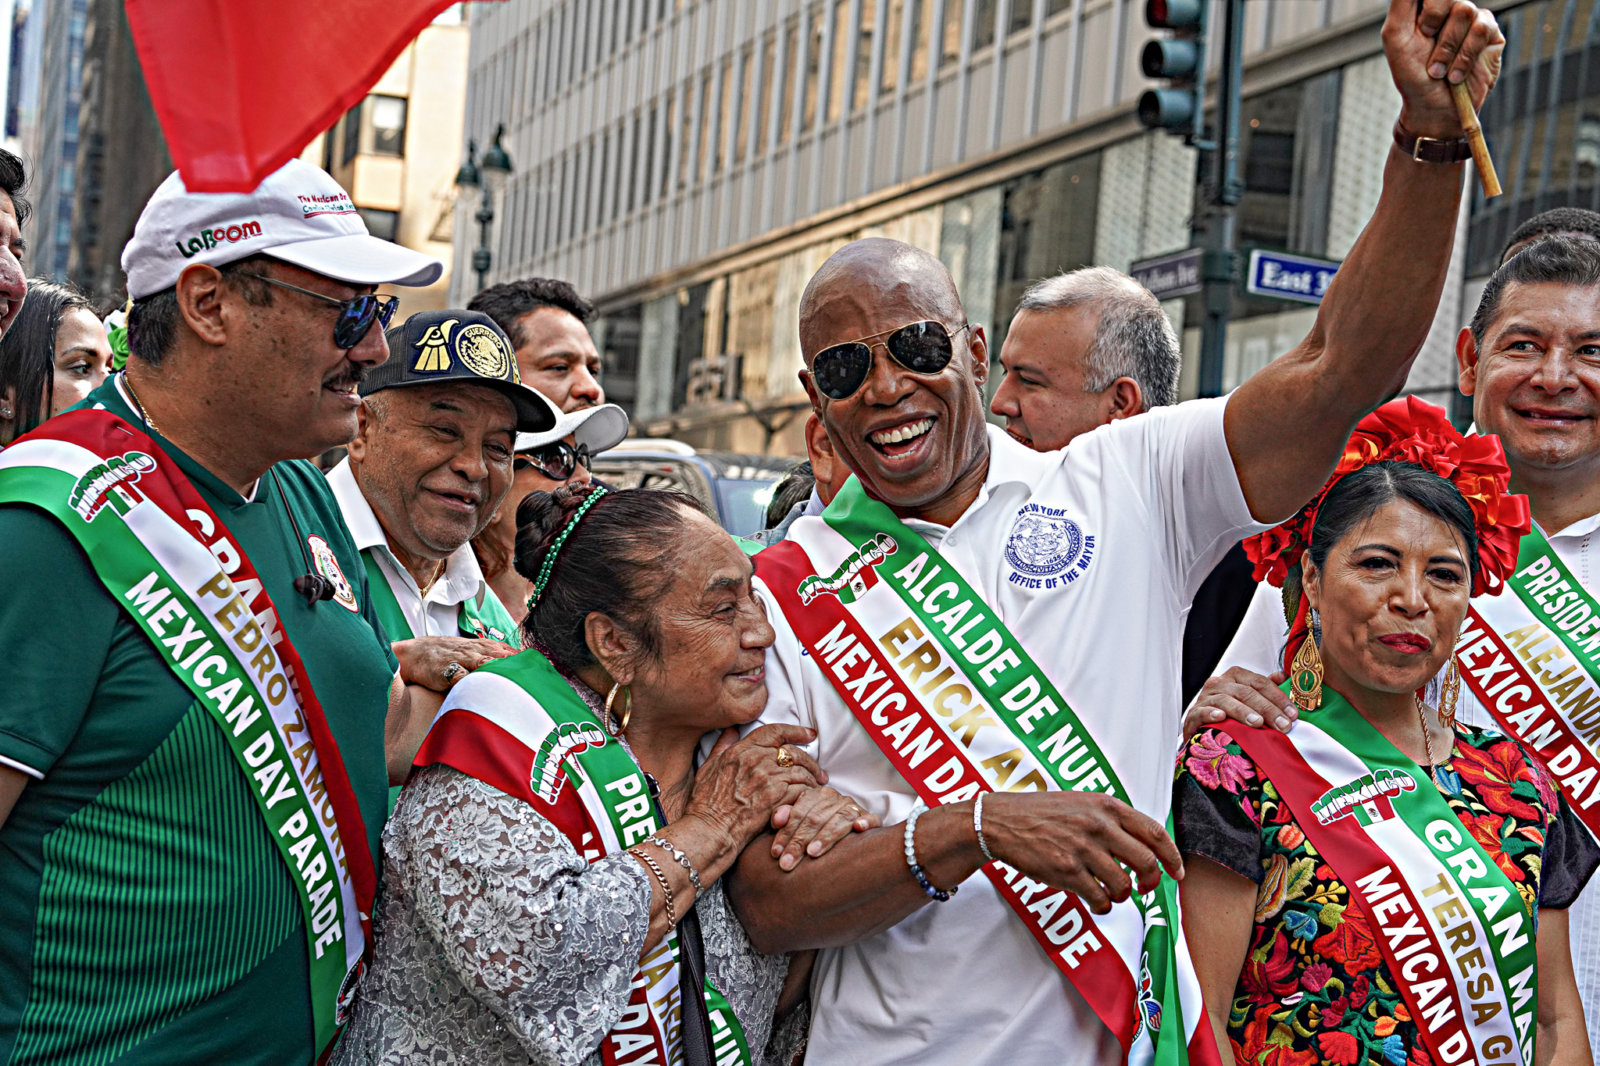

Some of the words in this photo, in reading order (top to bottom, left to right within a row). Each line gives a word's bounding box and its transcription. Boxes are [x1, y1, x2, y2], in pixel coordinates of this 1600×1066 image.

[464, 327, 502, 349] GUERRERO
[1261, 261, 1312, 294] East
[1314, 270, 1335, 296] 3
[1008, 571, 1041, 589] OFFICE
[1045, 577, 1058, 589] OF
[1059, 568, 1080, 585] THE
[1077, 535, 1095, 571] MAYOR
[1017, 503, 1039, 517] NEW
[1040, 505, 1068, 517] YORK
[196, 570, 288, 706] PEDRO
[814, 620, 944, 769] MEXICAN
[879, 616, 998, 748] ERICK
[893, 551, 1022, 688] ALCALDE
[1000, 674, 1058, 735] DE
[1038, 722, 1116, 797] NUE
[1454, 616, 1563, 752] MEXICAN
[124, 570, 262, 738] MEXICAN
[242, 730, 297, 810] DAY
[278, 808, 342, 960] PARADE
[1424, 819, 1528, 958] GRAN
[1355, 865, 1456, 1034] MEXICAN
[1437, 1029, 1476, 1066] D
[1421, 873, 1502, 1027] TERESA
[1482, 1035, 1516, 1066] G
